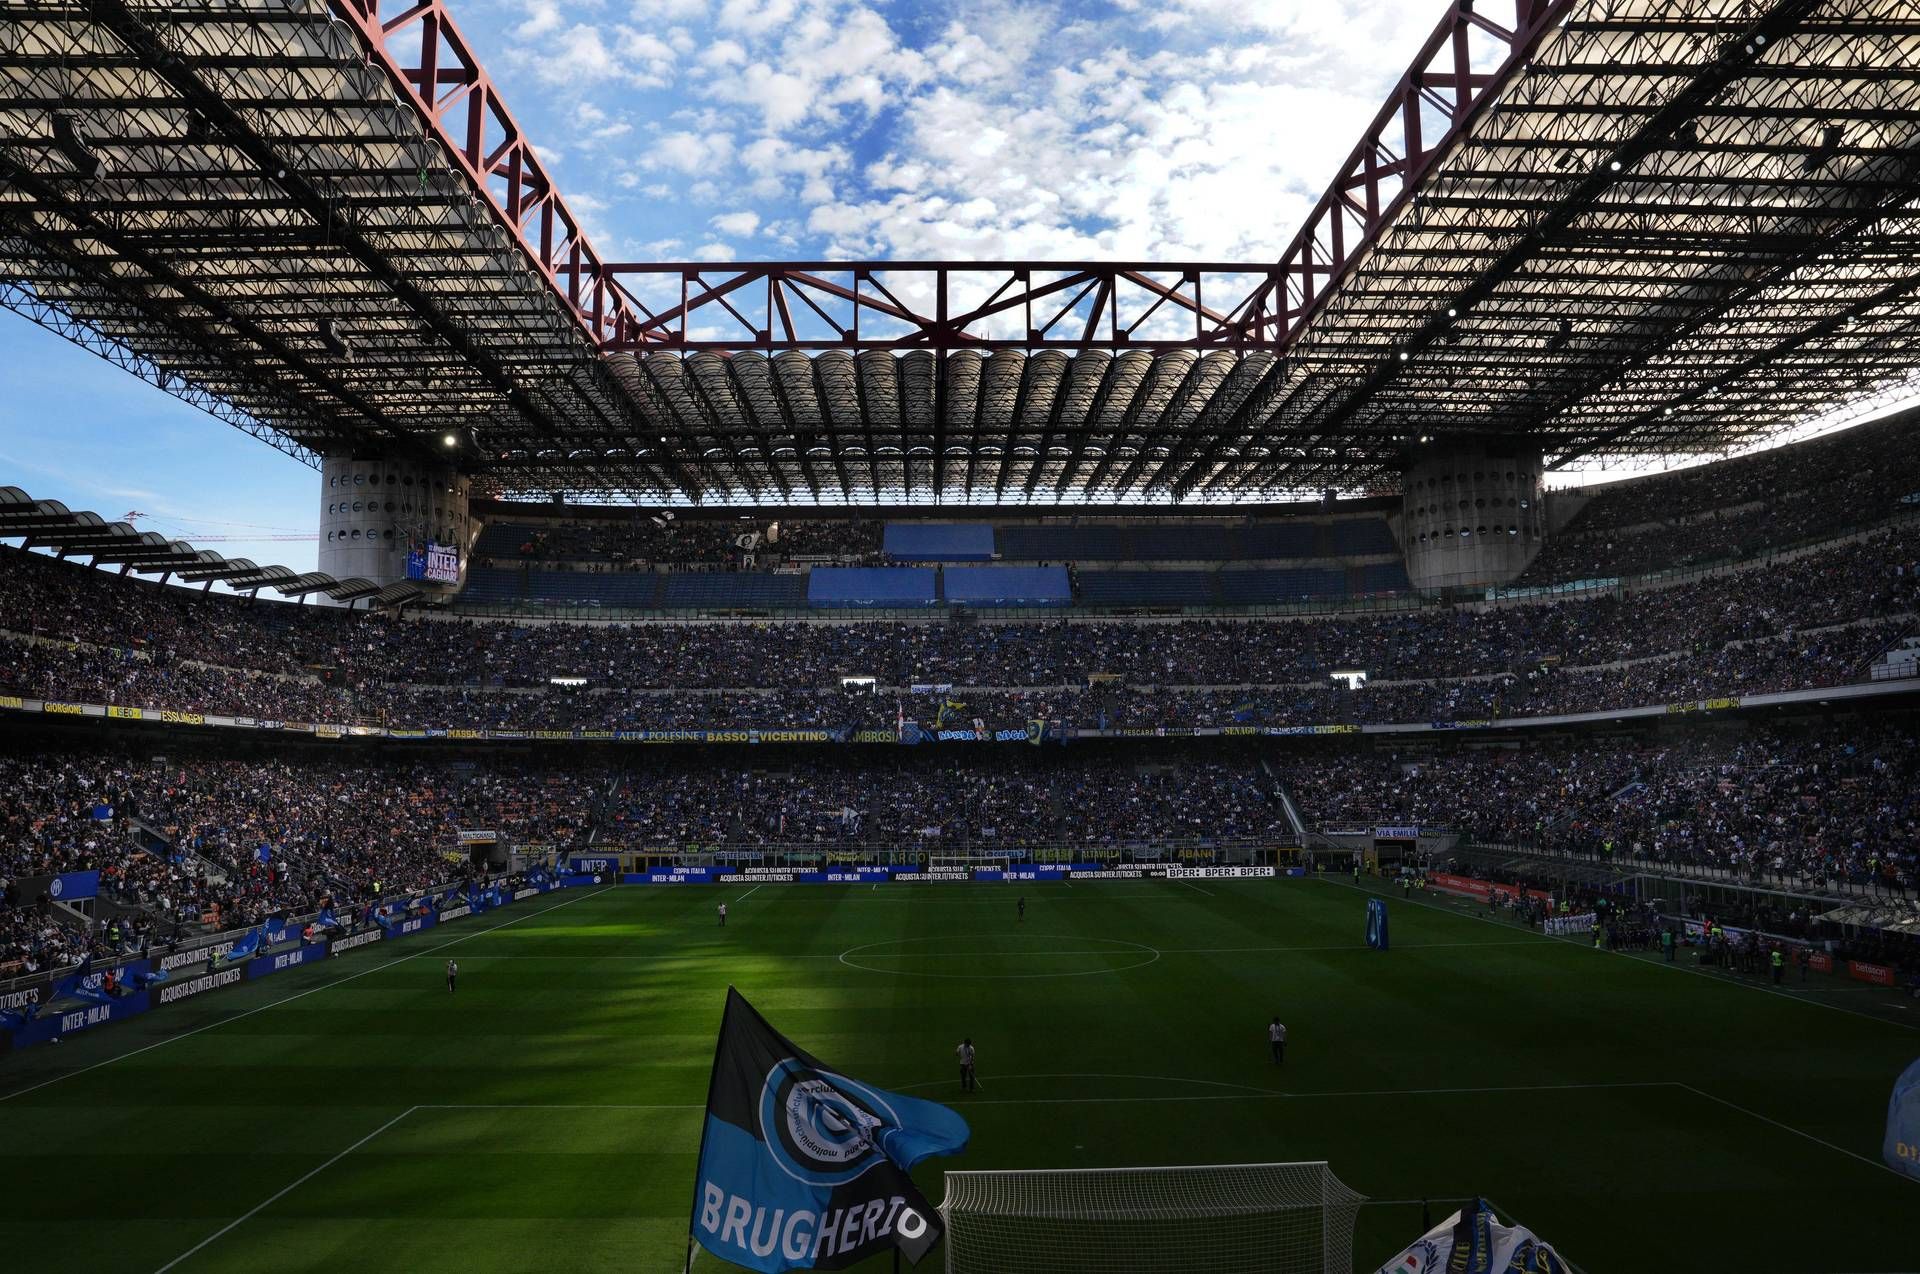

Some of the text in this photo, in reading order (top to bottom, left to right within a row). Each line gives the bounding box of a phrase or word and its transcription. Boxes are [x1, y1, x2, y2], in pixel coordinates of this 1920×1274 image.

[428, 551, 457, 570] INTER
[428, 568, 457, 582] CAGLIARI
[45, 702, 82, 714] GIORGIONE
[116, 708, 134, 717] ISEO
[162, 711, 204, 725] ESSLINGEN
[1224, 726, 1256, 736] SENAGO
[1313, 724, 1353, 735] CIVIDALE
[649, 730, 700, 741] POLESINE
[707, 732, 828, 742] BASSO VICENTINO
[581, 859, 607, 872] INTER
[720, 874, 744, 882] ACQUISTA
[895, 873, 919, 881] ACQUISTA
[1070, 871, 1093, 879] ACQUISTA
[1169, 868, 1271, 877] BPER: BPER: BPER:
[160, 951, 186, 971] ACQUISTA
[160, 982, 189, 1004] ACQUISTA
[700, 1180, 928, 1261] BRUGHERIO
